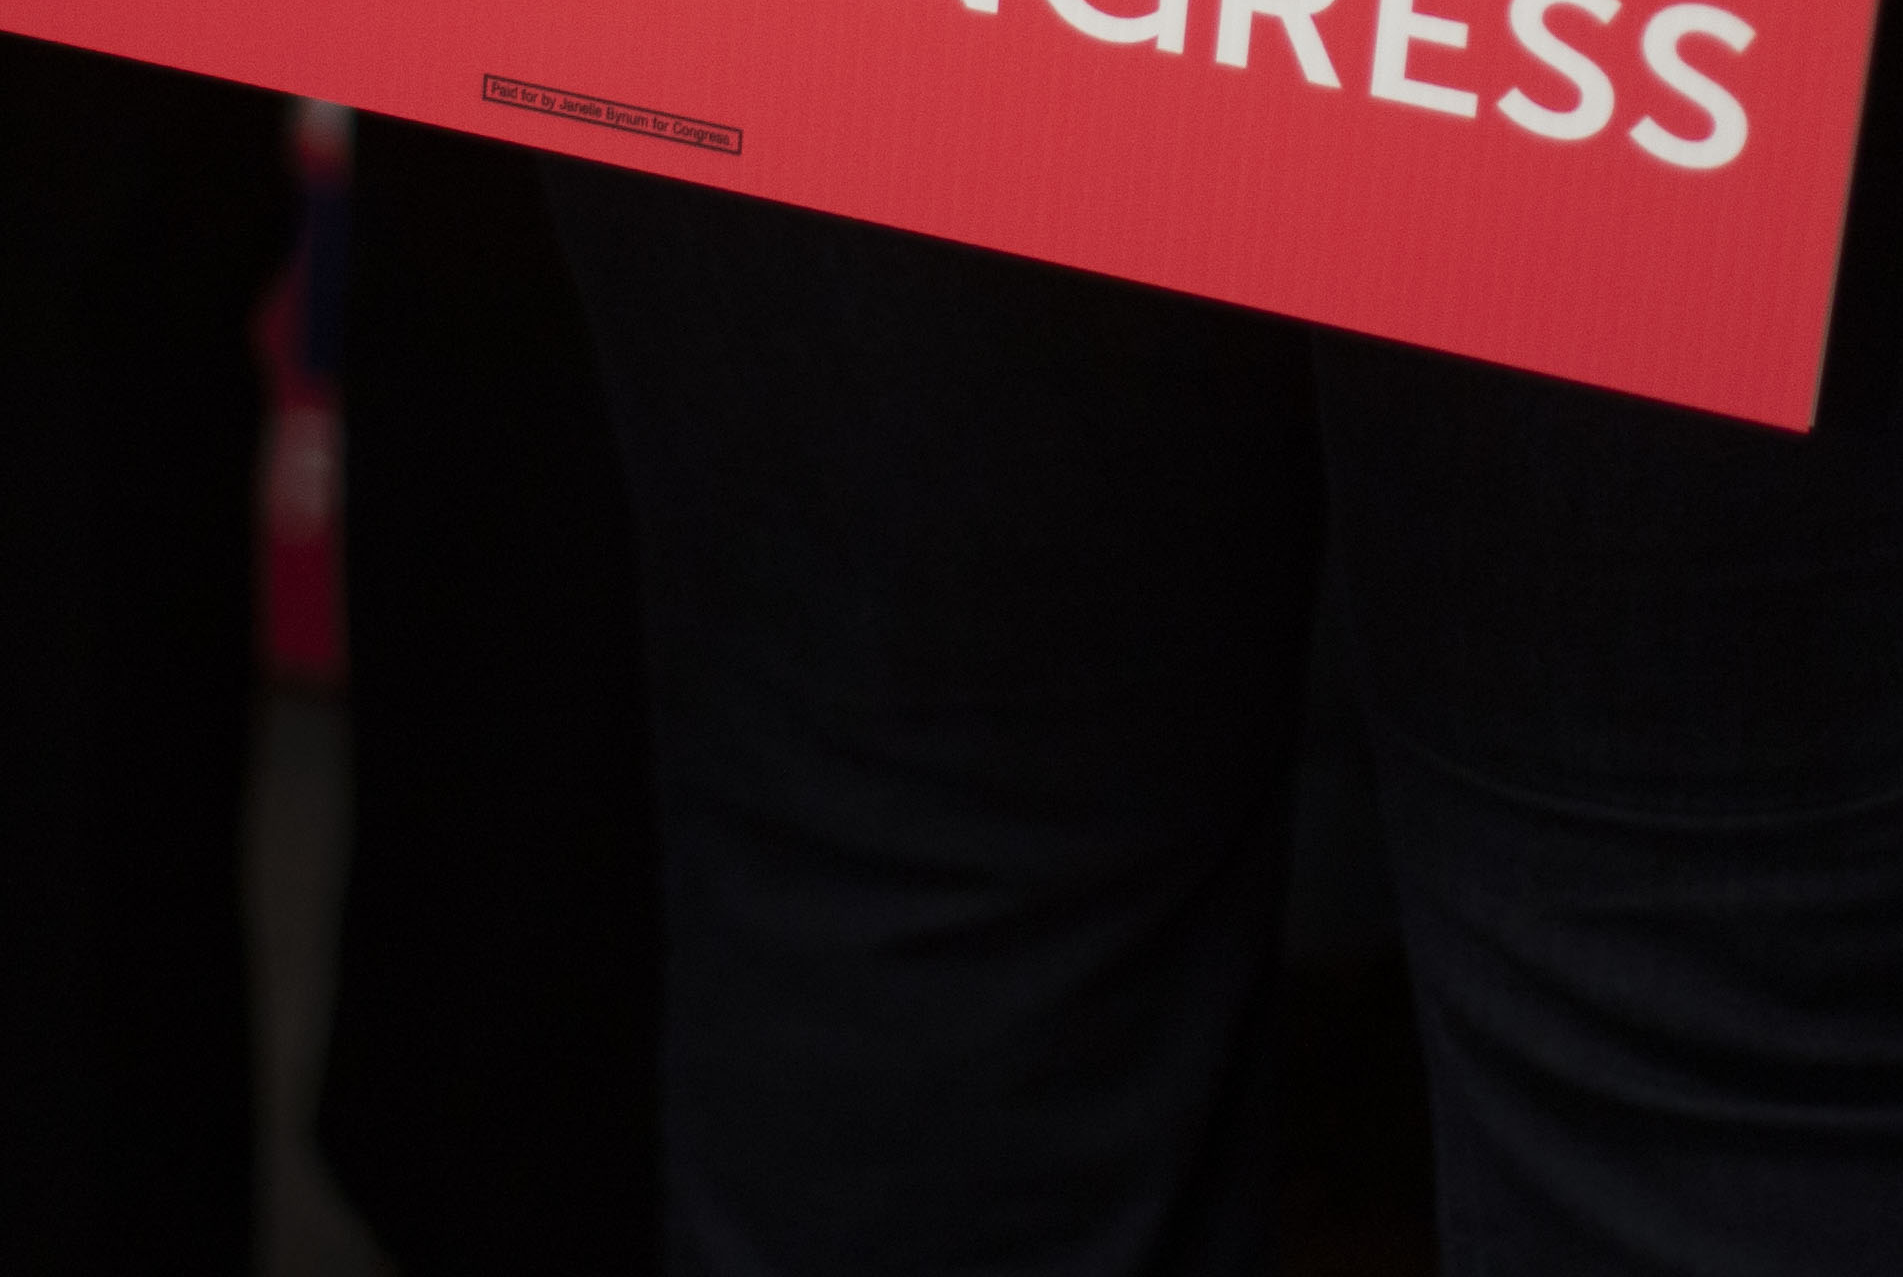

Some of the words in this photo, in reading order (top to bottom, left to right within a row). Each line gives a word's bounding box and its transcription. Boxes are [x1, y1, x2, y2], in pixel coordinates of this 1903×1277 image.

[491, 80, 518, 101] Paid
[521, 87, 539, 104] for
[541, 92, 556, 111] by
[559, 97, 602, 119] Janelle
[606, 106, 648, 127] Bynum
[652, 116, 669, 132] for
